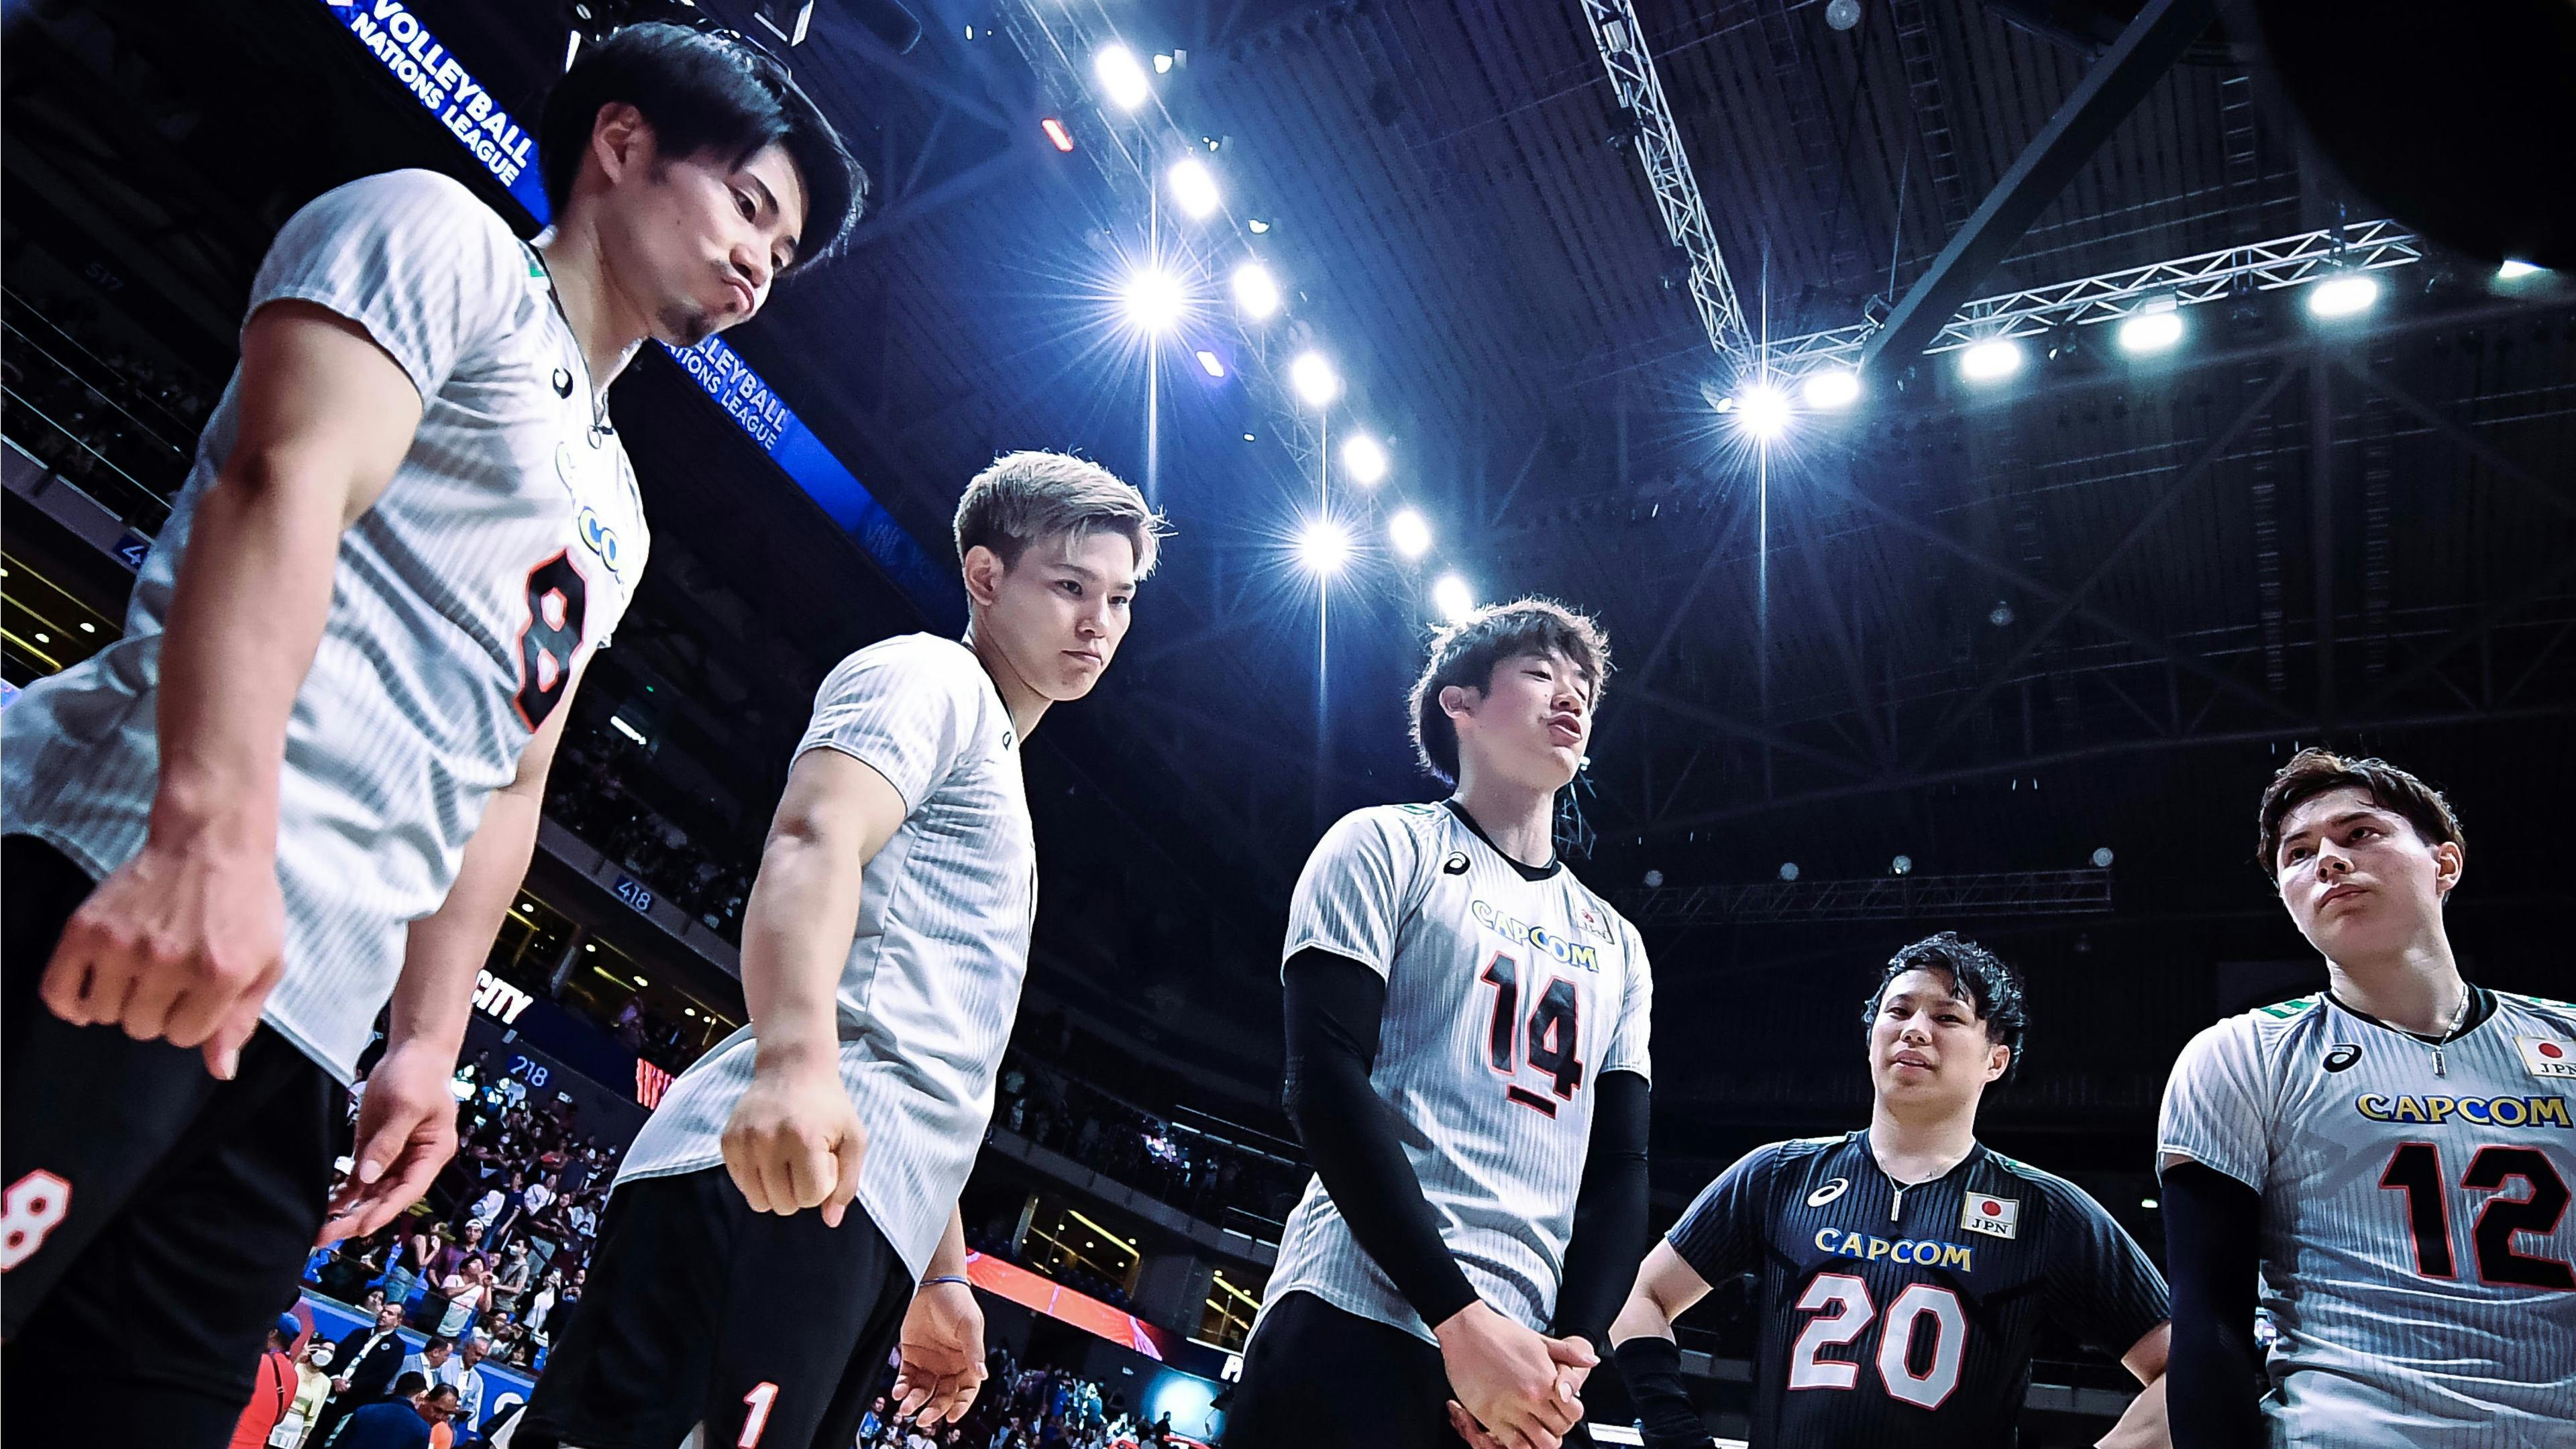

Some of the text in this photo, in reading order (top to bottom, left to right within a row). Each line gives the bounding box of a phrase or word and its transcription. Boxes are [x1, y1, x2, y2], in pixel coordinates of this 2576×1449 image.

[351, 12, 520, 187] NATIONS LEAGUE
[374, 0, 532, 168] VOLLEYBALL
[695, 338, 786, 433] LEYBALL
[721, 388, 777, 451] LEAGUE
[513, 547, 588, 735] 8
[618, 881, 651, 910] 418
[1472, 900, 1600, 973] CAPCOM
[472, 969, 534, 1025] CITY
[1480, 950, 1583, 1102] 14
[510, 1055, 548, 1087] 218
[2355, 1091, 2575, 1129] CAPCOM
[0, 1168, 73, 1273] 8
[1814, 1226, 1973, 1273] CAPCOM
[1971, 1219, 2008, 1235] JPN
[2377, 1142, 2576, 1292] 12
[1787, 1272, 1969, 1411] 20
[737, 1381, 780, 1449] 1
